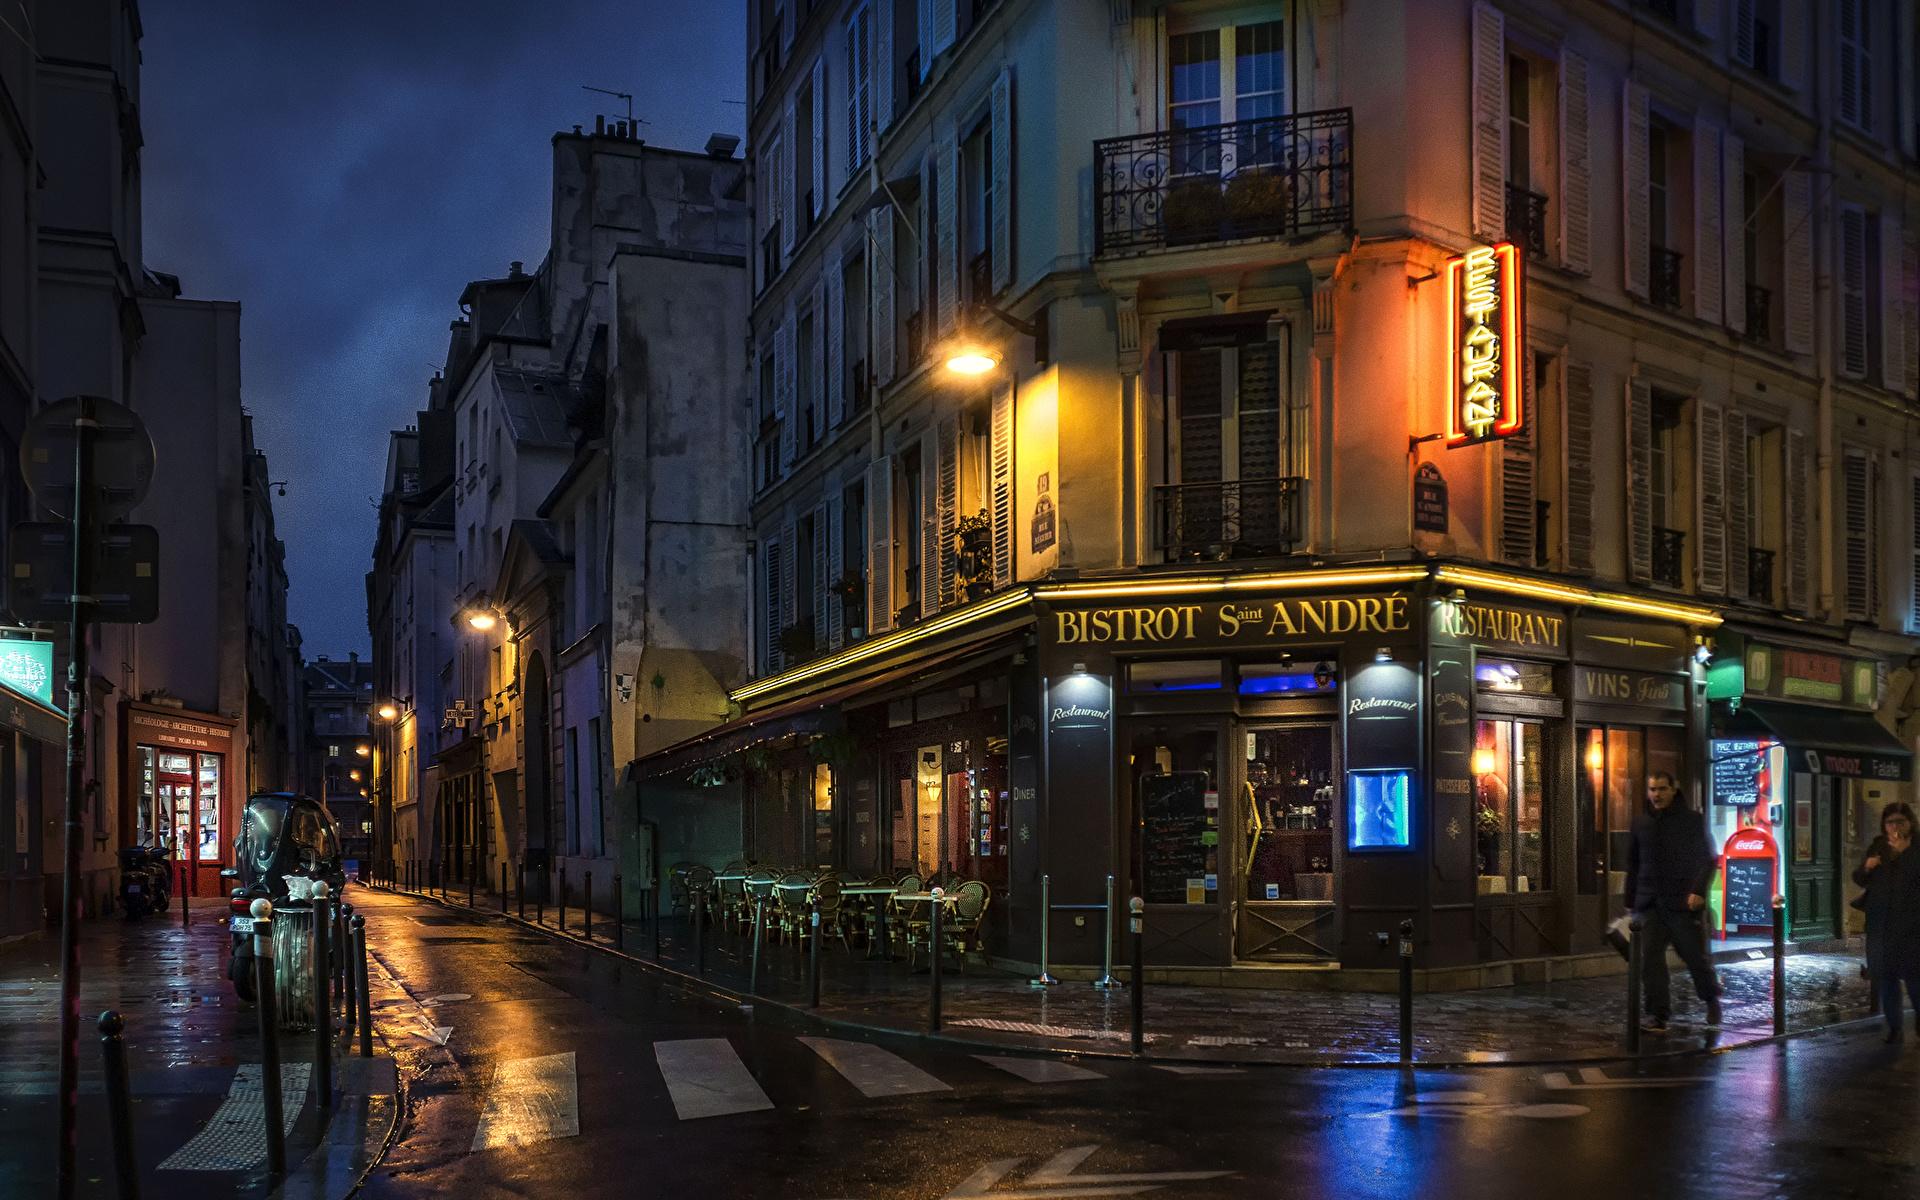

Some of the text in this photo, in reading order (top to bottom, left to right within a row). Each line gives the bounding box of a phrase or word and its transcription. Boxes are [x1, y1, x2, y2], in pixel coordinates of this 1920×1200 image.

[1463, 244, 1499, 438] RESTAURANT
[1056, 592, 1410, 644] BISTROT Saint ANDRÉ
[1440, 601, 1562, 647] RESTAURANT
[1585, 671, 1631, 698] VINS
[1050, 704, 1111, 723] Restaurant
[1349, 697, 1418, 715] Restaurant
